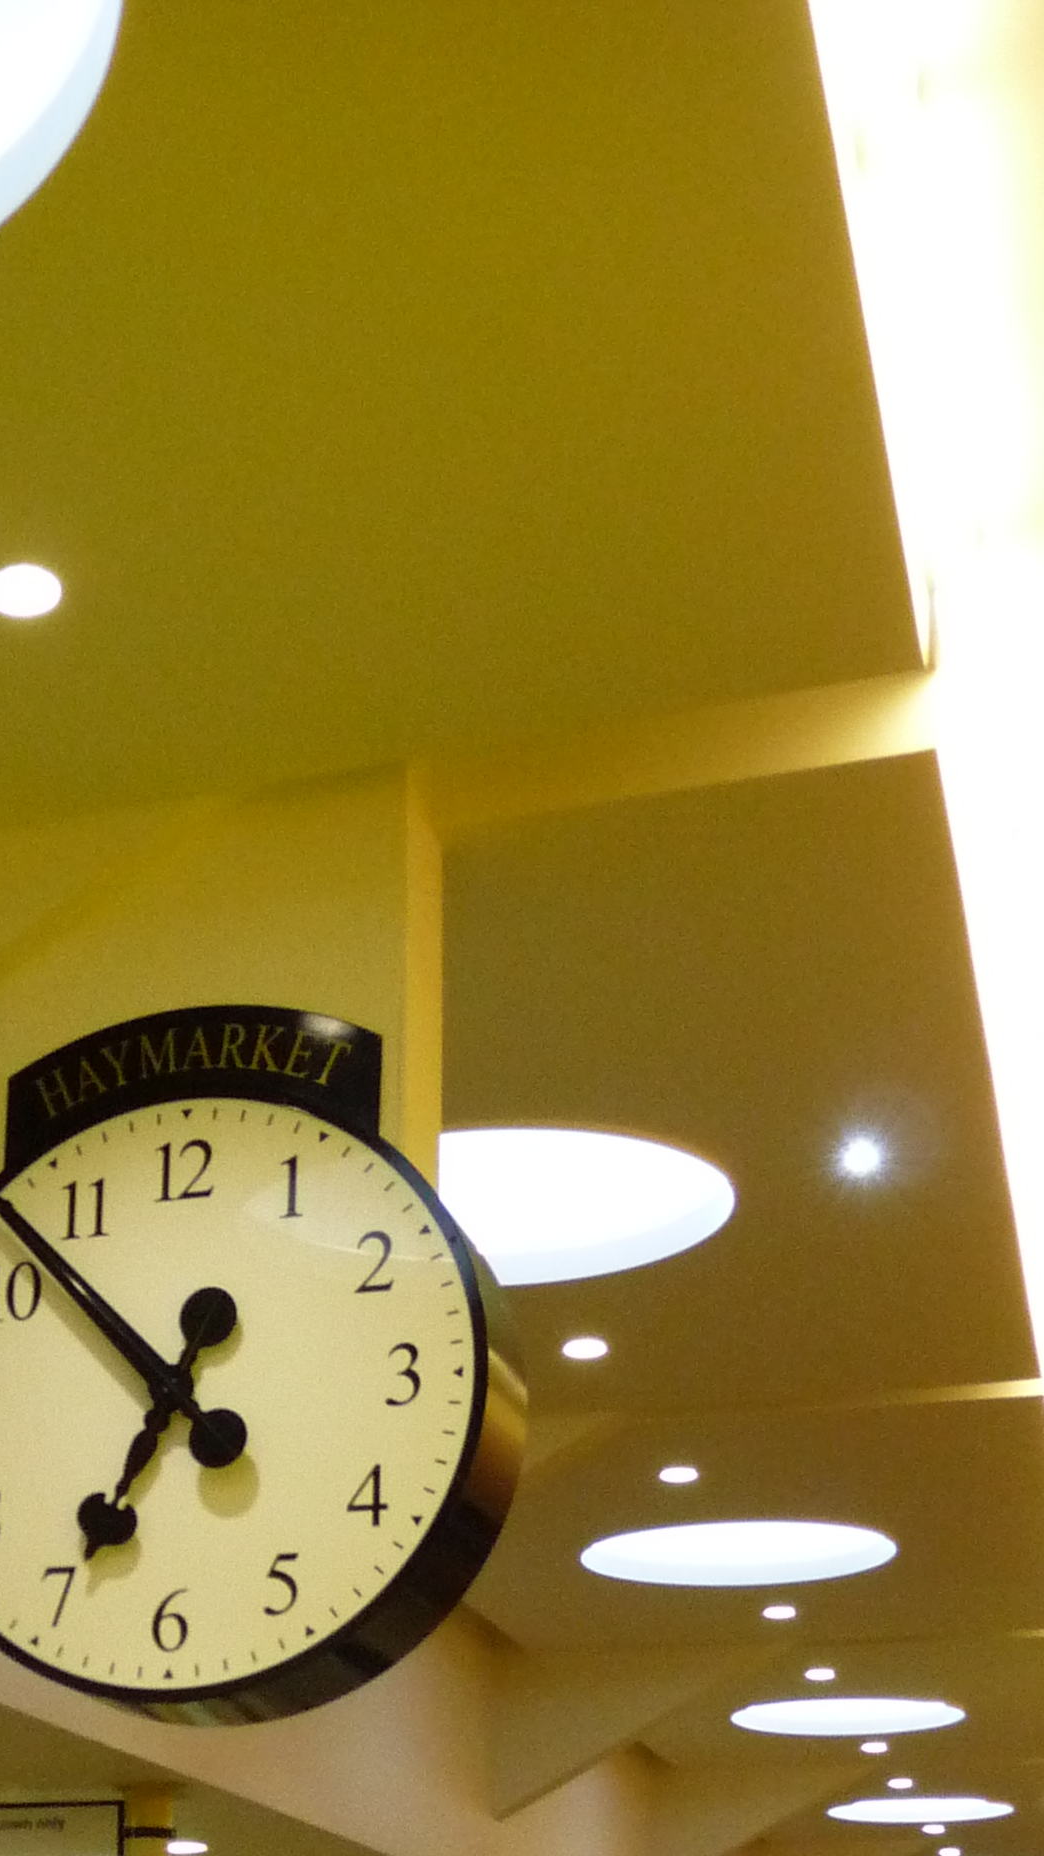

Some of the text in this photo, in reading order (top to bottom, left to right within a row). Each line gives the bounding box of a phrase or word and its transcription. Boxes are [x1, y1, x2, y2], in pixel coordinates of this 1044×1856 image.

[35, 1022, 352, 1120] HAYMARKET
[155, 1138, 214, 1203] 12
[279, 1155, 304, 1218] 1
[60, 1177, 111, 1241] 11
[356, 1230, 394, 1293] 2
[384, 1342, 421, 1406] 3
[346, 1463, 389, 1527] 4
[41, 1565, 77, 1627] 7
[262, 1552, 300, 1616] 5
[151, 1588, 189, 1652] 6
